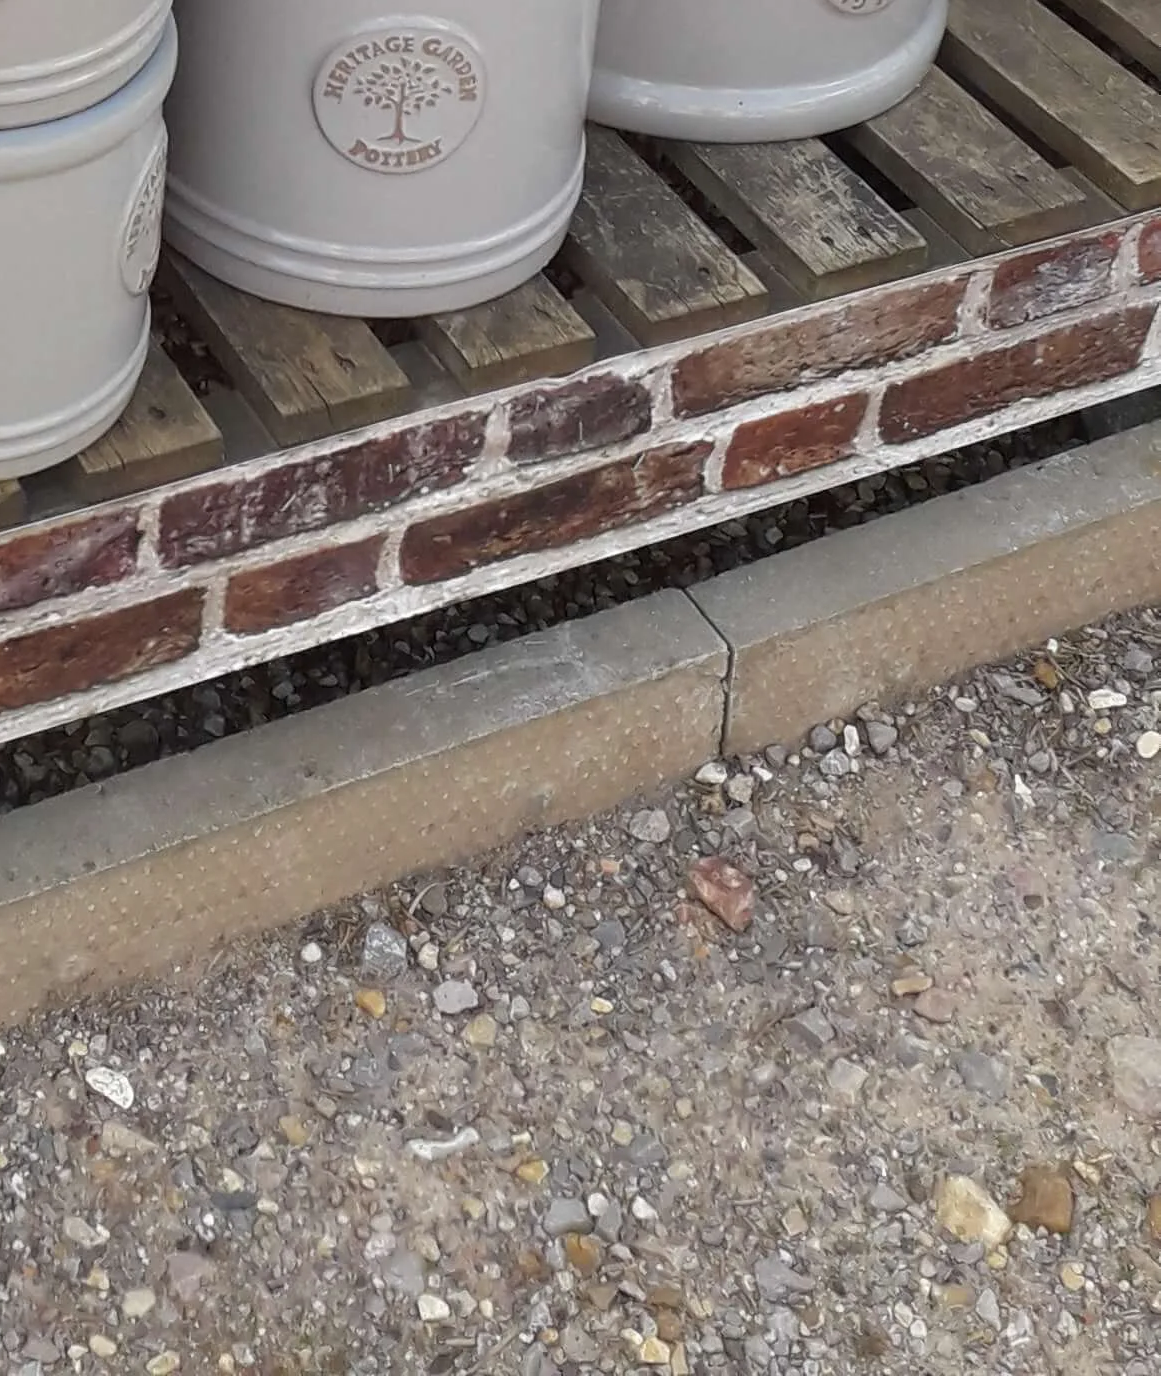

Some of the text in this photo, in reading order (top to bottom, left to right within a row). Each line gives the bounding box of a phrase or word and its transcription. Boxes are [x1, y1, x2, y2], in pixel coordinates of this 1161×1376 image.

[324, 36, 478, 102] HERITAGE GARDEN
[348, 138, 442, 167] POTTERY
